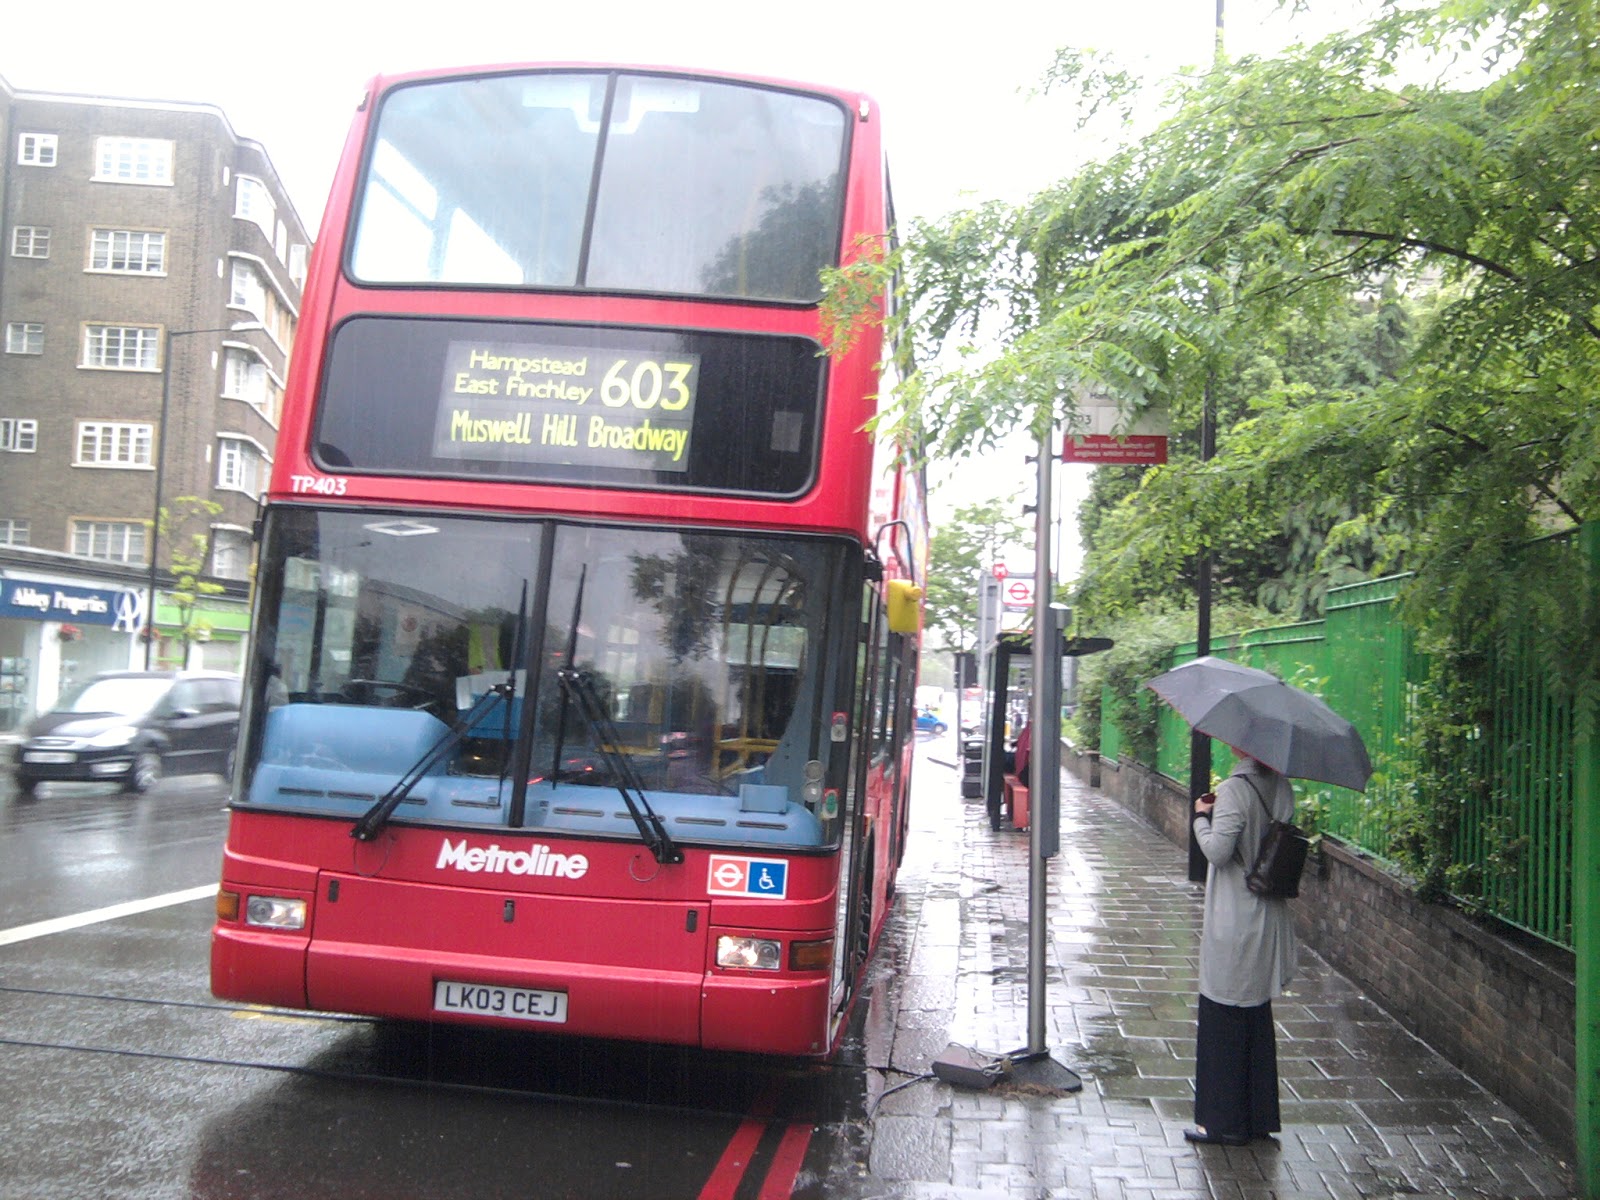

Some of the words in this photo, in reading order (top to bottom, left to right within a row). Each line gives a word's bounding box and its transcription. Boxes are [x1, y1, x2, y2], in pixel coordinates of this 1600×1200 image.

[469, 350, 588, 377] Hampstead
[454, 372, 499, 395] East
[506, 376, 594, 405] Finchley
[600, 360, 693, 411] 603
[451, 410, 532, 444] Muswell
[541, 414, 578, 447] Hill
[588, 415, 688, 462] Broadway
[290, 475, 348, 496] TP403
[436, 838, 589, 879] Metroline
[444, 985, 506, 1012] LK03
[512, 991, 559, 1017] CEJ
